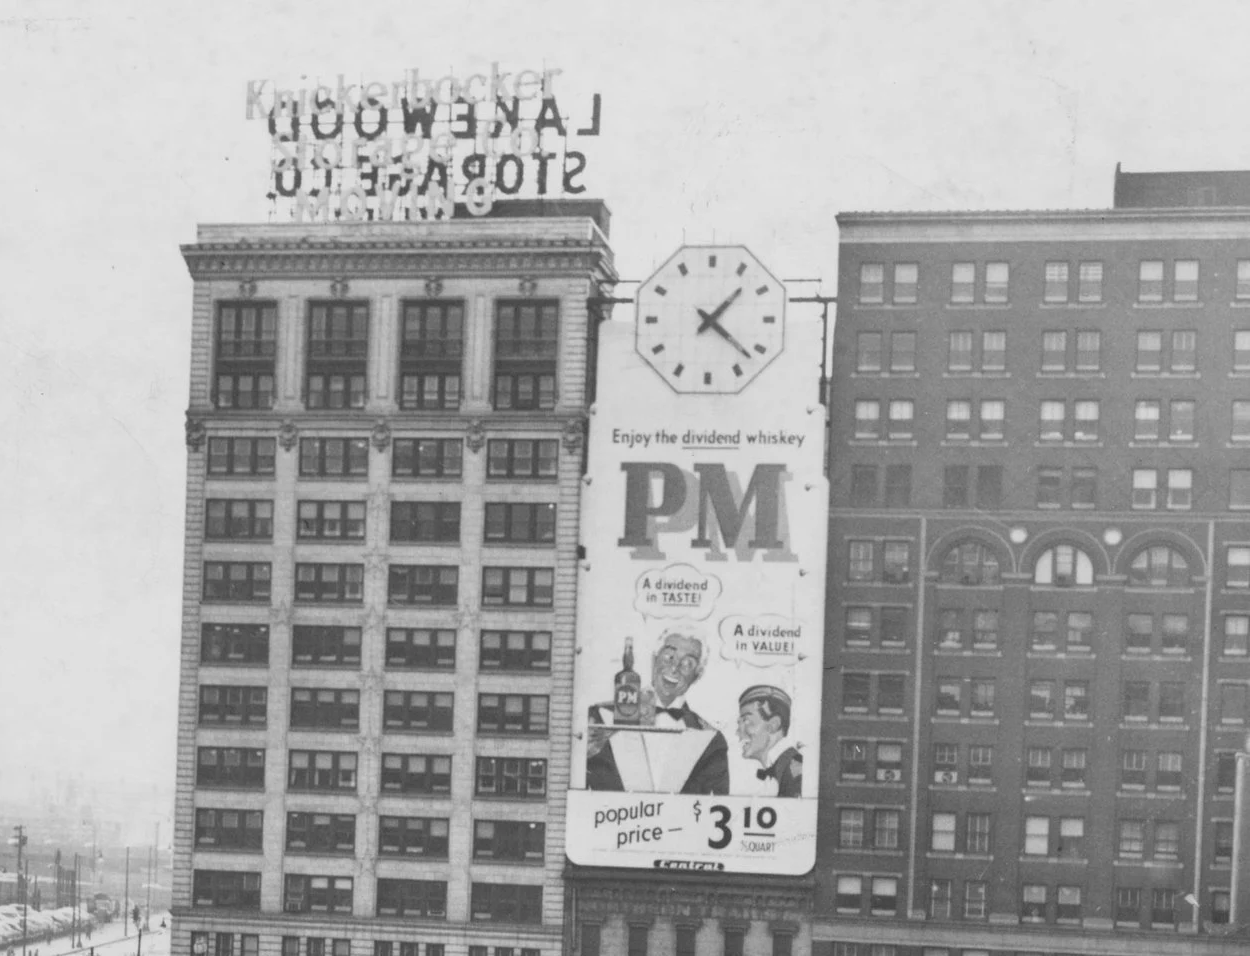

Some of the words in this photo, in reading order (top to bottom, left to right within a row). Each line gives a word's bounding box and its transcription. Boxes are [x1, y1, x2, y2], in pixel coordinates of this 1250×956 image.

[245, 61, 563, 121] Knickerbocker
[271, 131, 458, 178] Storage
[612, 429, 651, 448] Enjoy
[655, 429, 678, 445] the
[682, 429, 741, 445] dividend
[746, 429, 806, 448] whiskey
[617, 461, 793, 555] PM
[642, 578, 651, 590] A
[655, 578, 708, 591] dividend
[646, 592, 657, 603] in
[662, 592, 702, 604] TASTE!
[734, 624, 744, 637] A
[747, 625, 801, 638] dividend
[736, 641, 748, 651] in
[752, 641, 795, 653] VALUE!
[618, 690, 638, 704] PM
[594, 800, 664, 829] popular
[617, 825, 663, 849] price
